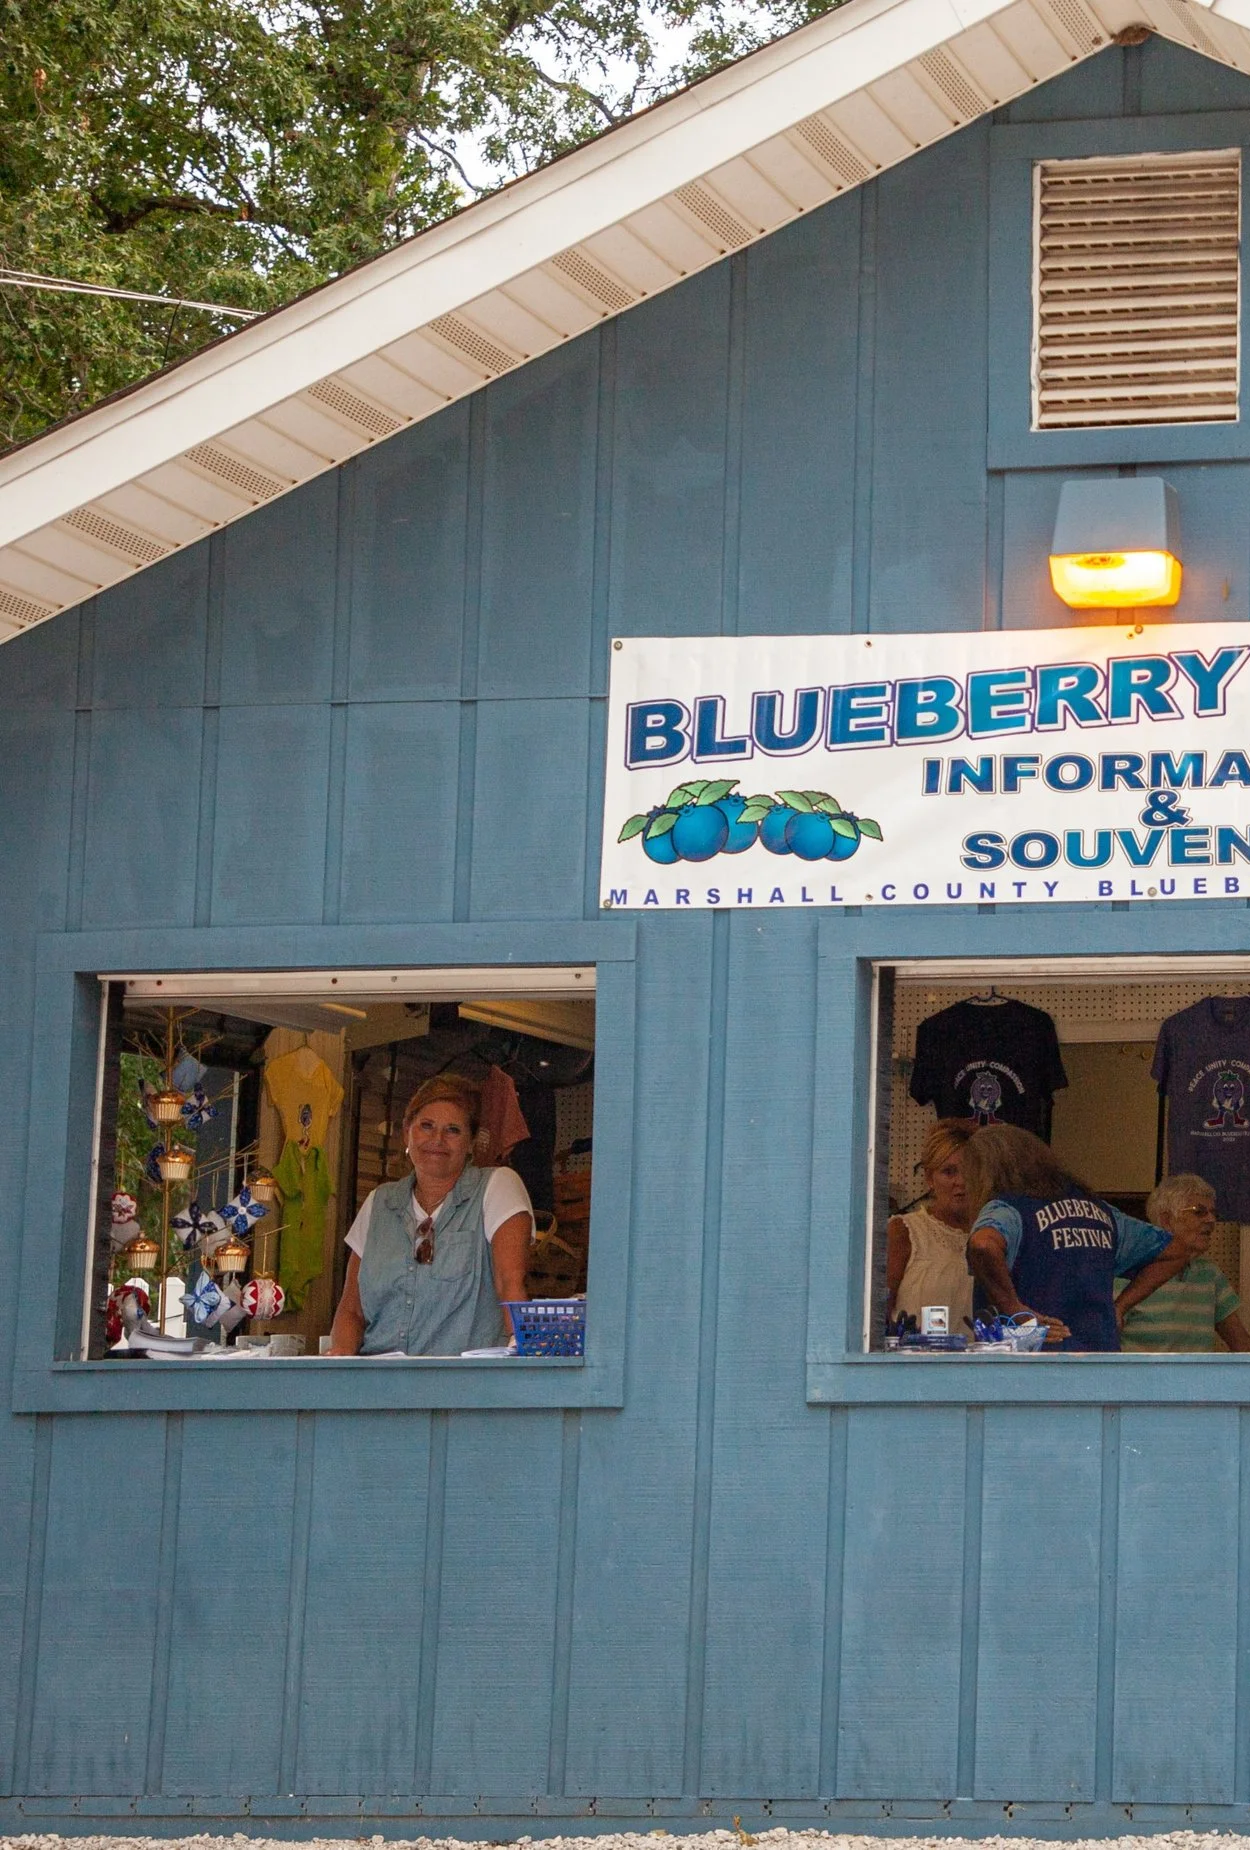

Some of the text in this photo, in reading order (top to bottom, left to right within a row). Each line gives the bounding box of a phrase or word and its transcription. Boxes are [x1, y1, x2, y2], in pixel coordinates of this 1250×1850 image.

[1139, 789, 1191, 828] &
[609, 886, 844, 906] MARSHALL
[881, 880, 1059, 900] COUNTY
[1188, 1070, 1205, 1092] PEACE
[1205, 1060, 1227, 1072] UNITY
